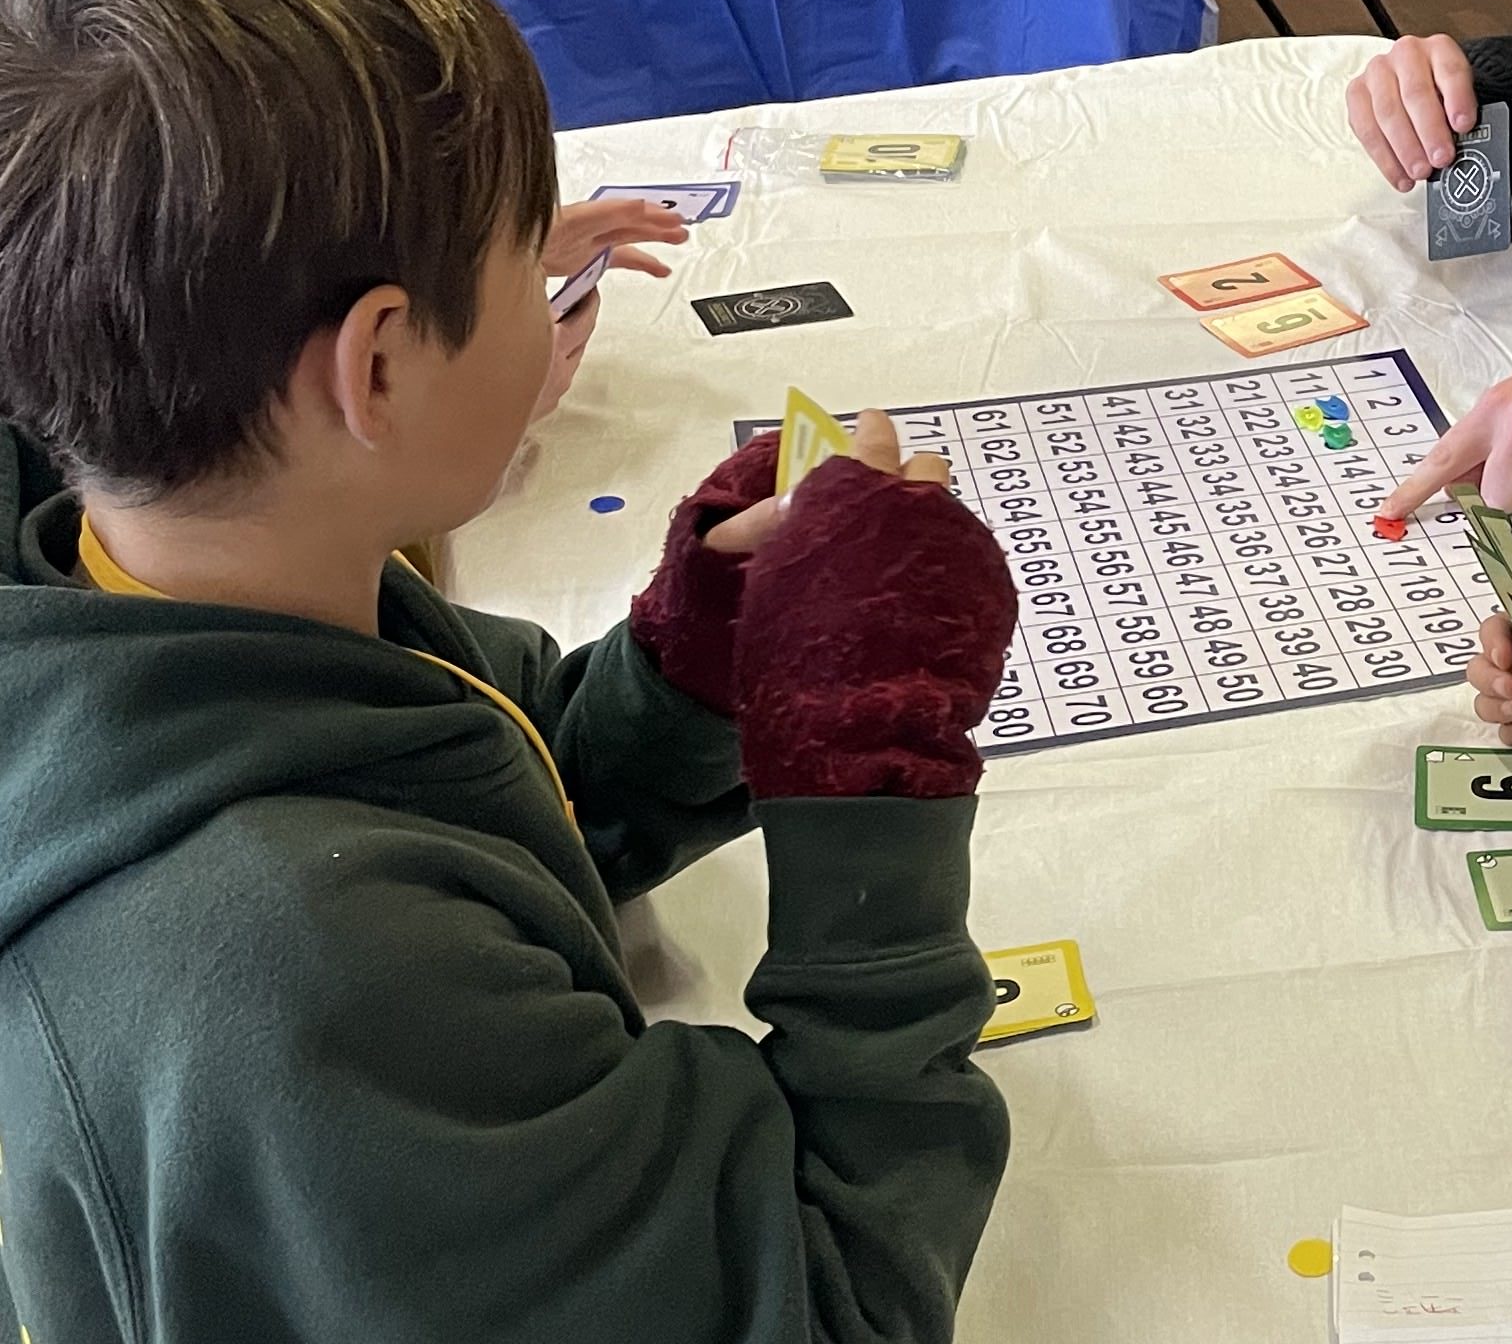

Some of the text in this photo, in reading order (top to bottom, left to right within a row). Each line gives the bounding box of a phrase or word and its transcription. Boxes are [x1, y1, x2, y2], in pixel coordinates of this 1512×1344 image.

[1211, 272, 1270, 290] 2
[1291, 374, 1328, 394] 11
[1355, 371, 1386, 379] 1
[1367, 397, 1401, 408] 2
[1384, 425, 1417, 435] 3
[1335, 456, 1374, 478] 14
[1350, 484, 1386, 508] 15
[1165, 389, 1337, 690] 31 32 33 34 35 36 37 38 39 40
[1227, 381, 1410, 678] 21 22 23 24 25 26 27 28 29 30
[1037, 404, 1188, 713] 51 52 53 54 55 56 57 58 59 60
[1103, 398, 1262, 701] 41 42 43 44 45 46 47 48 49 50
[1383, 545, 1427, 566] 17
[906, 417, 945, 439] 71
[988, 707, 1034, 737] 80
[972, 411, 1112, 725] 61 62 63 64 65 66 67 68 69 70
[1401, 576, 1444, 601] 18
[1420, 608, 1462, 632] 19
[1434, 638, 1482, 666] 20
